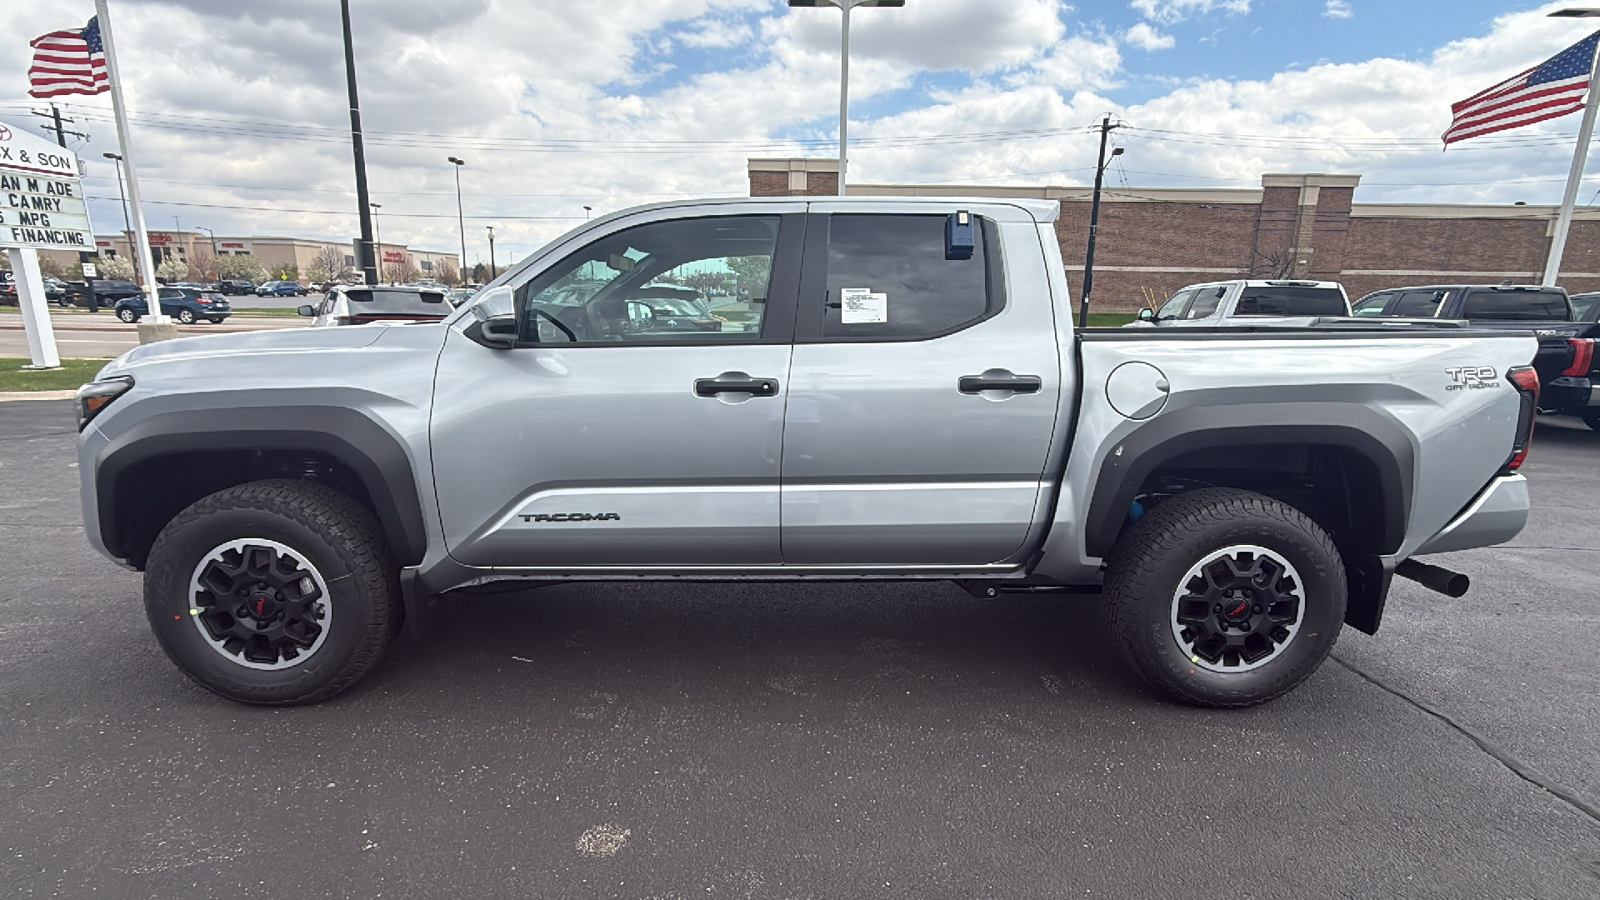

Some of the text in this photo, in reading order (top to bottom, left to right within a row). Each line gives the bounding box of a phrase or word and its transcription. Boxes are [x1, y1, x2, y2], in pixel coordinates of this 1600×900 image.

[20, 149, 32, 163] &
[37, 152, 71, 169] SON
[1, 175, 20, 190] AN
[8, 193, 61, 211] CAMRY
[19, 211, 51, 227] MPG
[11, 227, 84, 245] FINANCING
[1445, 366, 1497, 385] TRD
[518, 513, 620, 522] TACOMA
